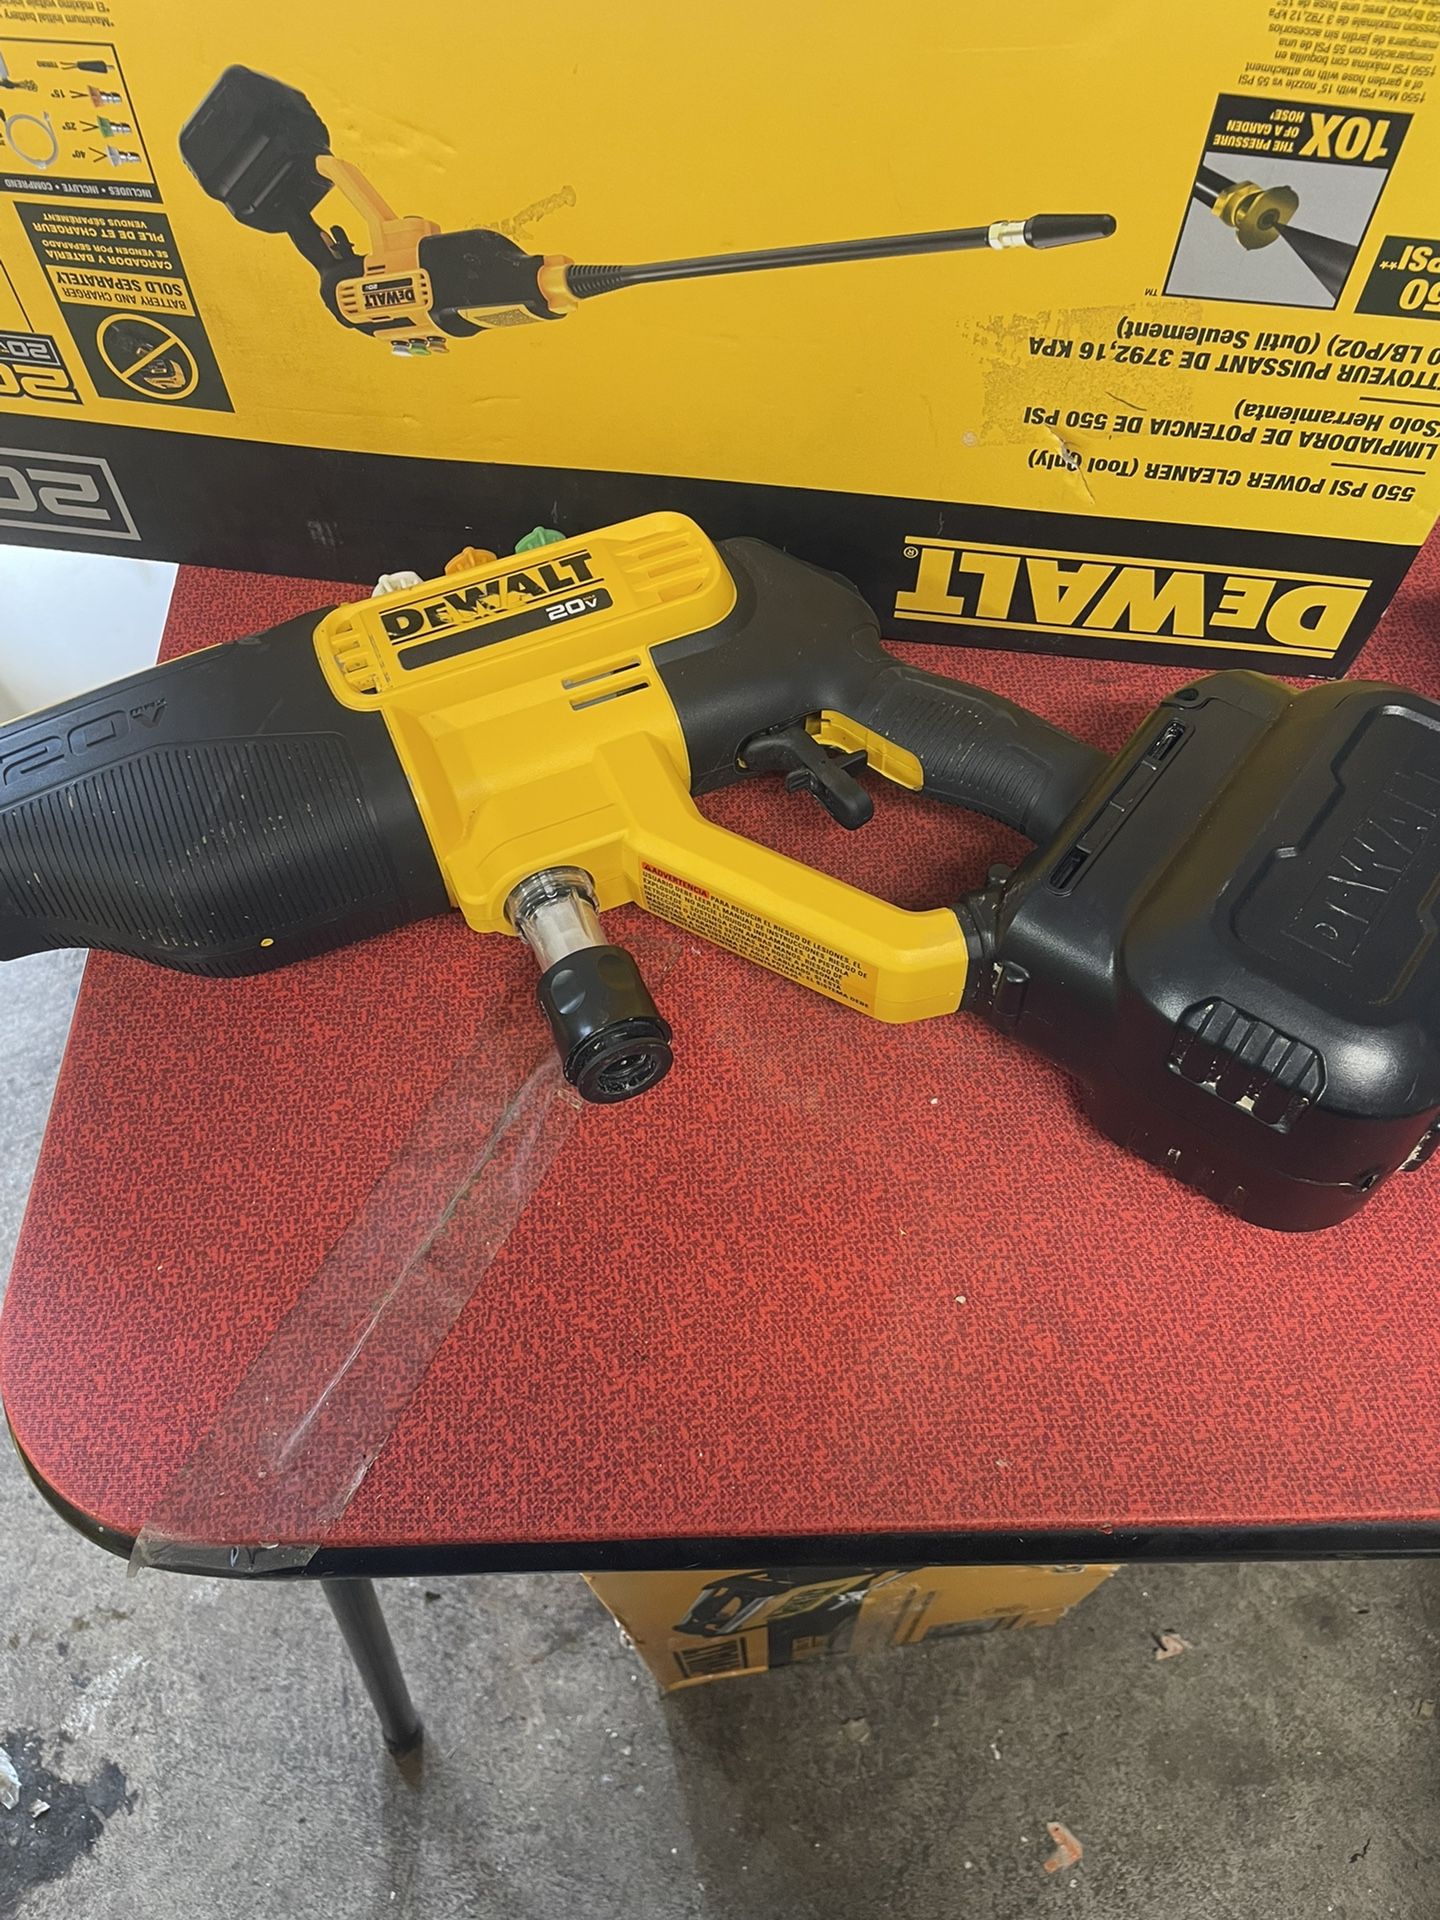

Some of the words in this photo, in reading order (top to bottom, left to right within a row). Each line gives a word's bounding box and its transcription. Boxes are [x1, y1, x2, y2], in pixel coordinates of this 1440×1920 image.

[1268, 23, 1322, 38] accesorios
[1324, 30, 1340, 40] sin
[1278, 37, 1298, 48] una
[1299, 40, 1312, 52] de
[1372, 34, 1386, 46] de
[1274, 50, 1288, 60] en
[1312, 42, 1332, 55] PSI
[1333, 44, 1347, 55] 55
[1348, 46, 1368, 56] con
[1290, 52, 1330, 66] boquilla
[1330, 56, 1350, 66] con
[1244, 62, 1302, 76] attachment
[1302, 68, 1316, 78] no
[1318, 70, 1339, 81] with
[1392, 64, 1410, 76] PSI
[1238, 72, 1256, 86] PSI
[1256, 76, 1270, 88] 55
[1272, 78, 1283, 87] vs
[1285, 79, 1316, 90] nozzle
[1341, 72, 1366, 84] hose
[1367, 75, 1402, 88] garden
[1404, 80, 1412, 88] a
[1411, 80, 1424, 90] of
[1336, 86, 1358, 96] with
[1358, 88, 1377, 99] PSI
[1378, 90, 1400, 101] Max
[1226, 120, 1272, 134] GARDEN
[1274, 124, 1284, 136] A
[1286, 126, 1300, 137] OF
[1212, 133, 1272, 150] PRESSURE
[1298, 112, 1390, 162] 10X
[1274, 140, 1295, 153] THE
[4, 178, 54, 190] COMPREND
[61, 182, 100, 194] INCLUYE
[108, 186, 152, 198] INCLUDES
[32, 222, 96, 237] CHARGEUR
[107, 218, 147, 229] VENDUS
[100, 228, 116, 238] ET
[117, 230, 135, 240] DE
[138, 232, 165, 244] PILE
[42, 239, 92, 250] SEPARADO
[92, 244, 113, 253] POR
[114, 246, 154, 256] VENDEN
[44, 249, 94, 263] BATERÍA
[98, 255, 106, 264] Y
[155, 250, 169, 258] SE
[108, 256, 172, 270] CARGADOR
[56, 272, 142, 292] SEPARATELY
[145, 282, 182, 296] SOLD
[61, 288, 112, 302] CHARGER
[114, 293, 136, 305] AND
[364, 288, 416, 308] DEWALT
[139, 296, 187, 310] BATTERY
[1116, 316, 1250, 350] Seulement)
[1028, 336, 1074, 358] KPA
[1254, 332, 1321, 356] (Outil
[1078, 340, 1174, 368] 3792,16
[1178, 350, 1211, 370] DE
[1214, 354, 1332, 381] PUISSANT
[1336, 364, 1440, 391] TTOYEUR
[1023, 406, 1060, 426] PSI
[1065, 410, 1108, 430] 550
[1234, 398, 1384, 432] Herramienta)
[1112, 415, 1144, 434] DE
[1150, 418, 1258, 443] POTENCIA
[1260, 428, 1292, 446] DE
[1298, 431, 1438, 460] LIMPIADORA
[1028, 448, 1082, 472] Only)
[1086, 458, 1139, 478] (Tool
[1144, 462, 1242, 486] CLEANER
[1246, 472, 1326, 494] POWER
[1328, 479, 1368, 498] PSI
[1371, 483, 1416, 502] 550
[380, 551, 596, 642] DEWALT
[641, 869, 674, 889] USUARIO
[674, 884, 693, 898] DEBE
[693, 893, 712, 907] LEER
[712, 901, 720, 911] EL
[721, 906, 753, 927] MANUAL
[754, 921, 764, 932] DE
[828, 955, 856, 974] RIESGO
[857, 969, 867, 980] DE
[688, 909, 722, 930] LESIONES
[758, 942, 770, 952] NO
[709, 893, 729, 908] PARA
[730, 903, 762, 923] REDUCIR
[762, 918, 771, 927] EL
[772, 922, 800, 941] RIESGO
[801, 936, 811, 946] DE
[852, 960, 861, 969] EL
[683, 895, 695, 906] NO
[806, 952, 816, 962] LA
[817, 957, 848, 977] PISTOLA
[688, 903, 727, 927] SOSTENGA
[727, 921, 744, 935] CON
[744, 929, 772, 948] AMBAS
[804, 957, 831, 975] RIESGO
[832, 970, 842, 980] DE
